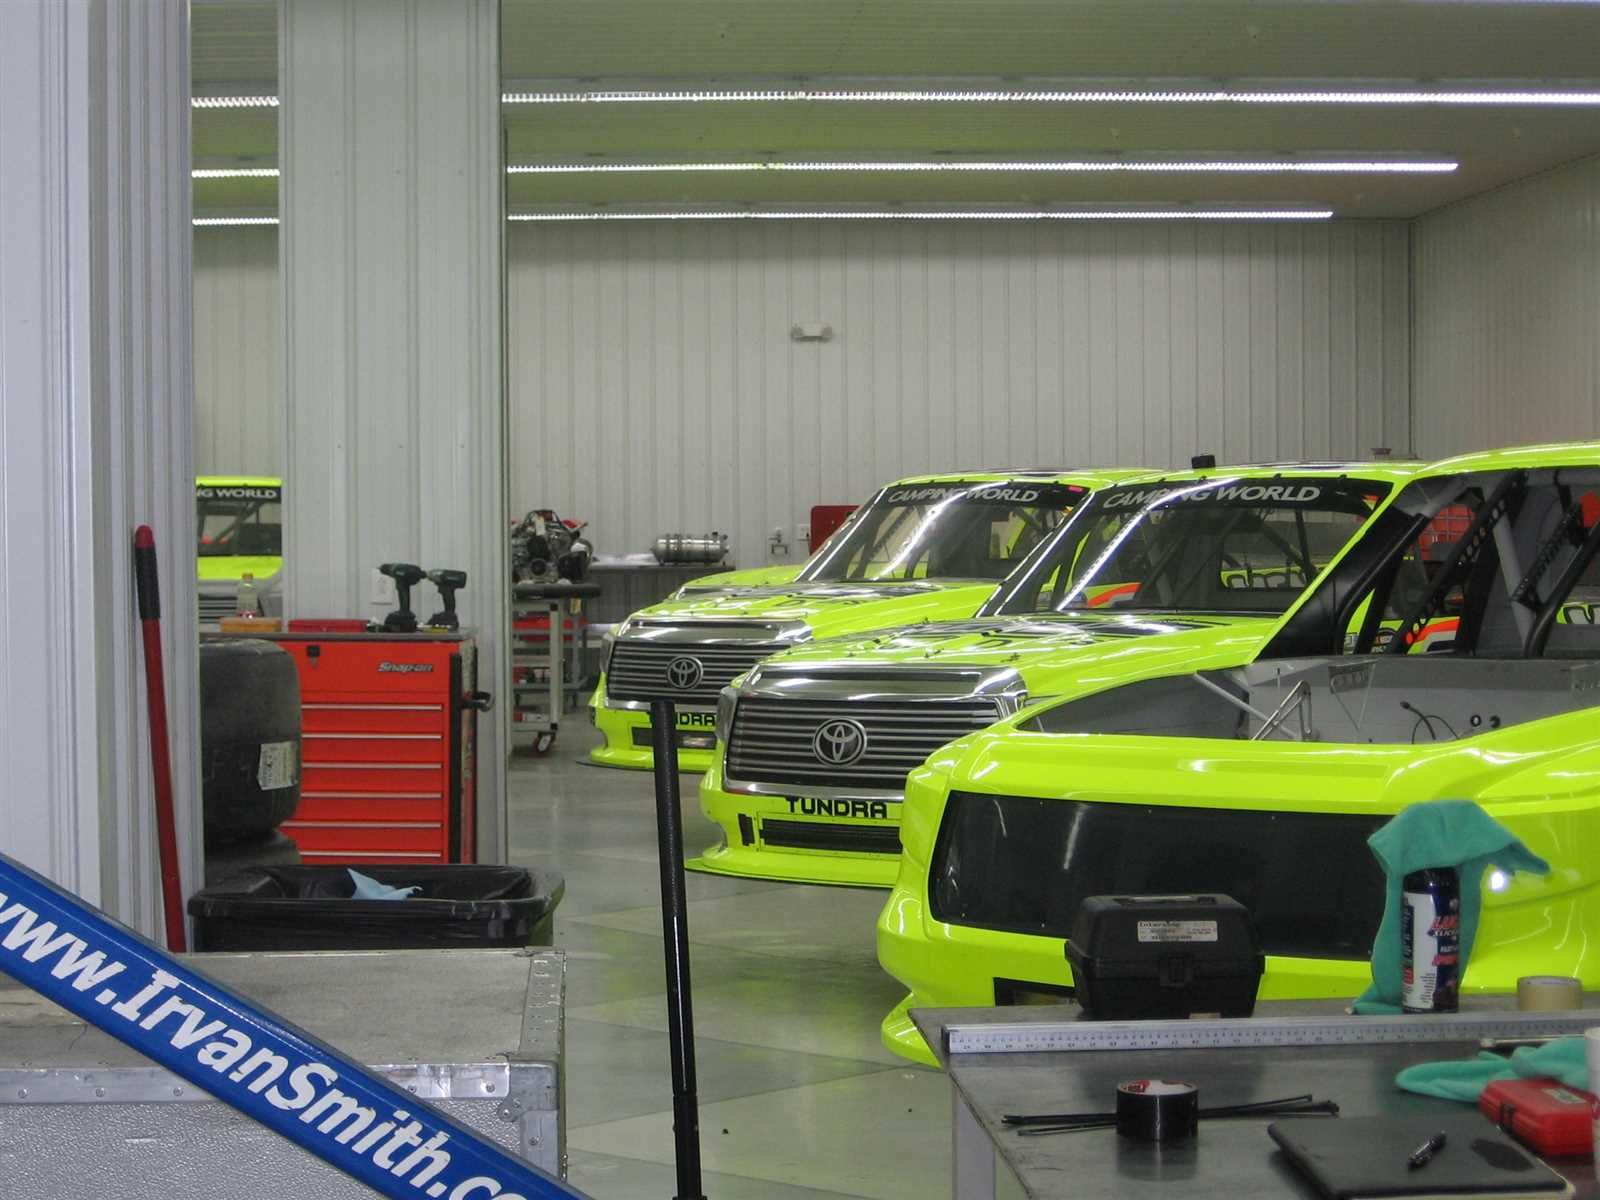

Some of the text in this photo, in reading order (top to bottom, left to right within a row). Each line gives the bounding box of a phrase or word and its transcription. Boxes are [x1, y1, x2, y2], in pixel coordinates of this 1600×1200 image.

[216, 488, 277, 498] WORLD
[966, 488, 1039, 502] WORLD
[1215, 486, 1320, 501] WORLD
[785, 796, 888, 819] TUNDRA
[0, 892, 527, 1200] ww.IrvanSmith.c
